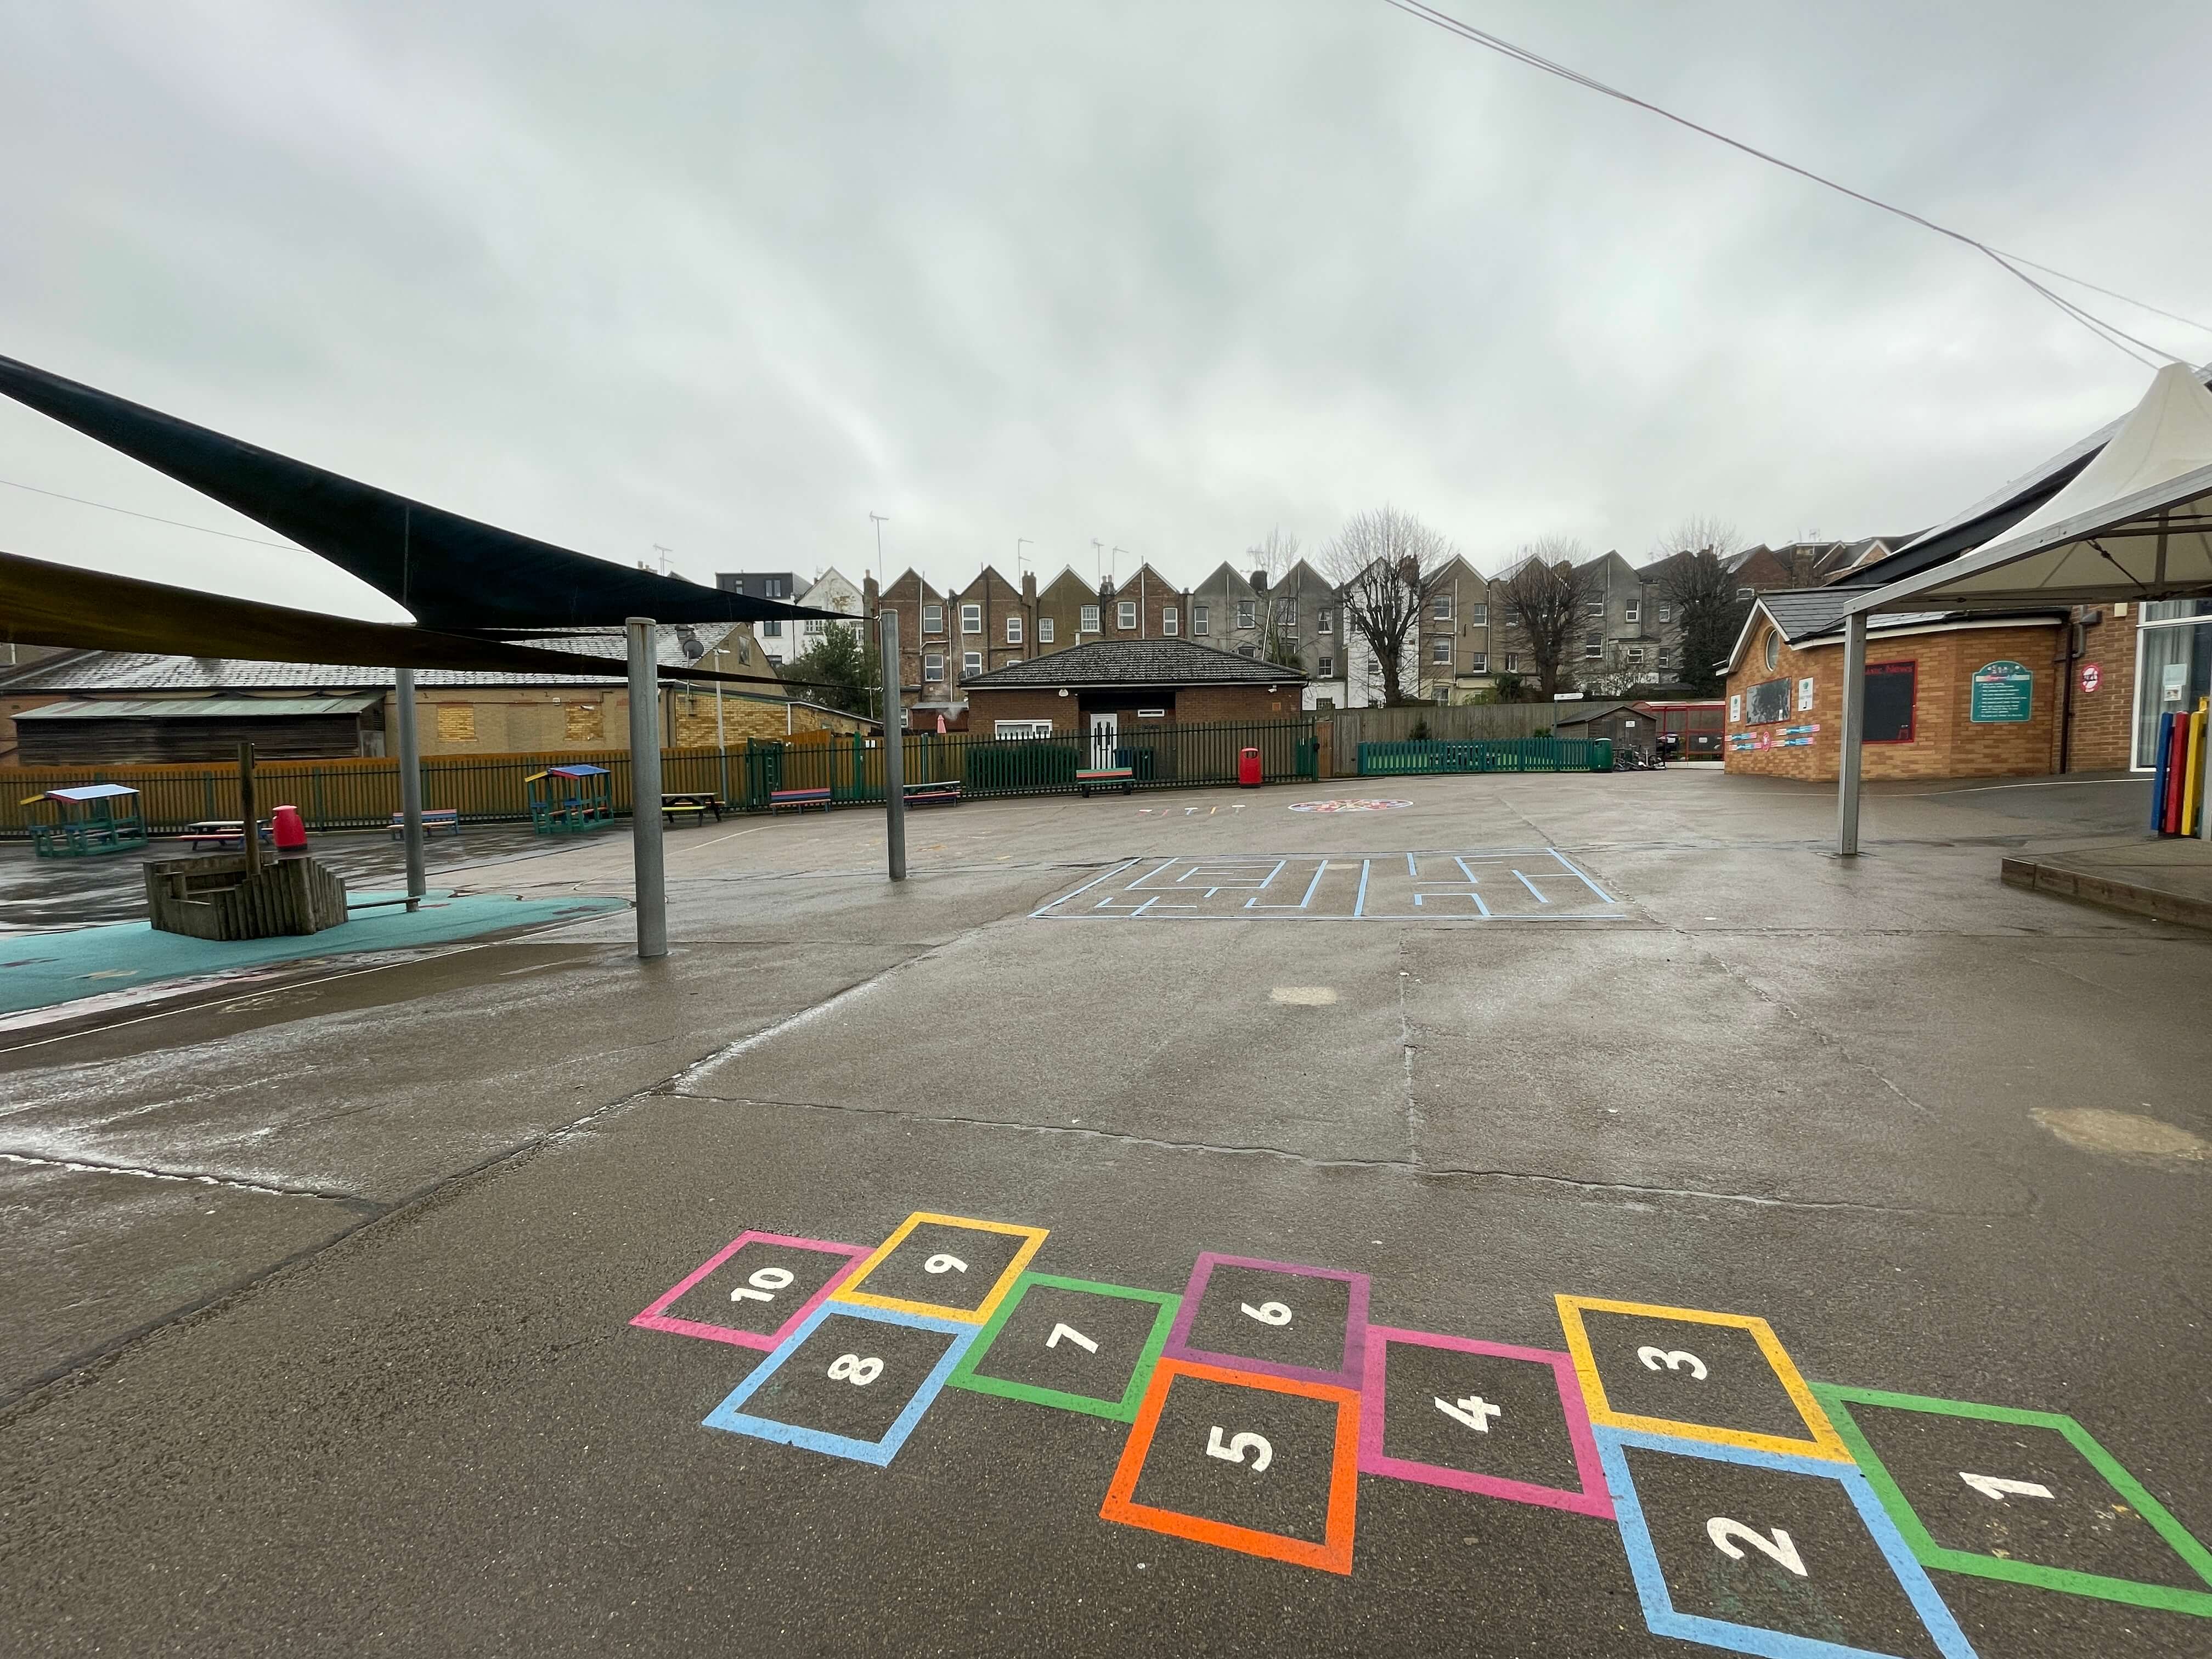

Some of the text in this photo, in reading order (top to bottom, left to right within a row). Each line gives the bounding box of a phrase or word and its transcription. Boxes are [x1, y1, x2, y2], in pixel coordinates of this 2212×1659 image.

[924, 1252, 969, 1274] 9
[730, 1266, 795, 1303] 10
[1240, 1301, 1293, 1327] 6
[1045, 1321, 1099, 1355] 7
[827, 1353, 884, 1386] 8
[1637, 1345, 1708, 1381] 3
[1434, 1395, 1502, 1434] 4
[1205, 1424, 1274, 1474] 5
[1959, 1471, 2055, 1501] 1
[1706, 1516, 1809, 1577] 2
